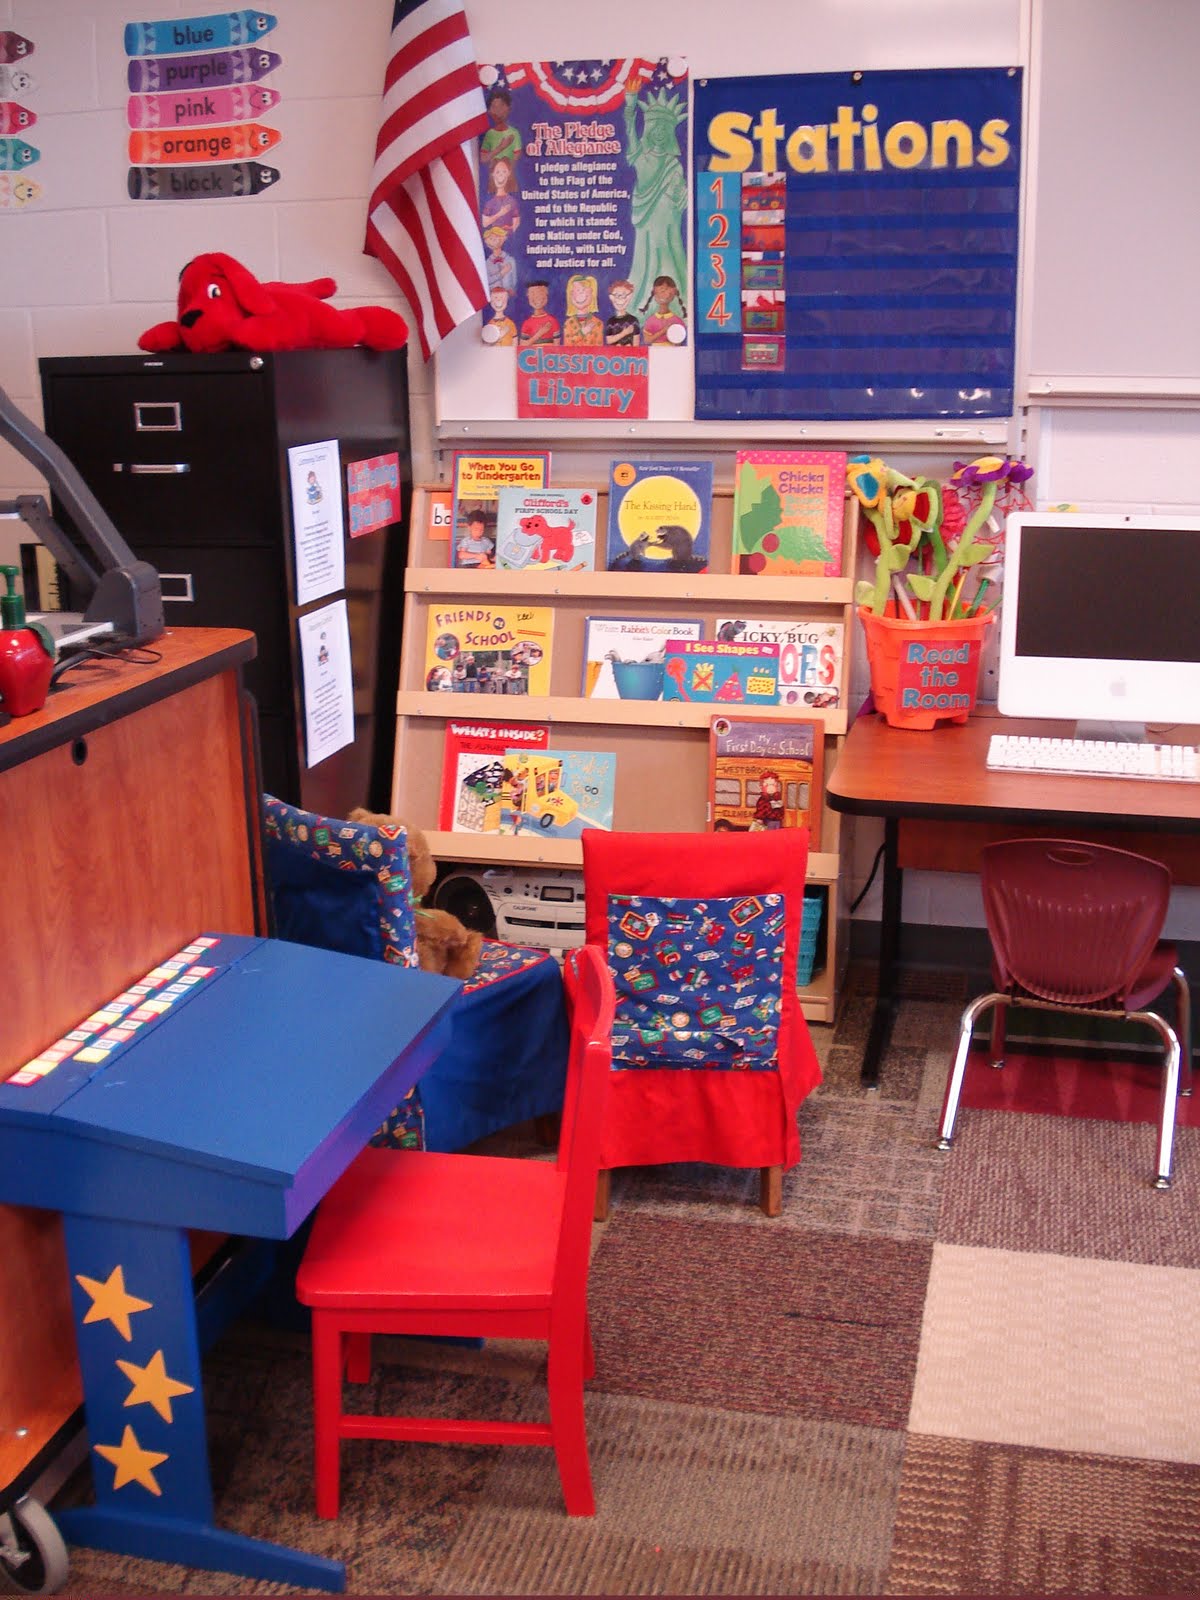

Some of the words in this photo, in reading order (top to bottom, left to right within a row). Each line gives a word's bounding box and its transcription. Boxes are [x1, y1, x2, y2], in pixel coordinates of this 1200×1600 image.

[172, 26, 214, 46] blue
[166, 59, 228, 85] purple
[175, 98, 216, 123] pink
[532, 122, 562, 139] The
[564, 121, 615, 140] Pledge
[707, 103, 1010, 173] Stations
[163, 135, 232, 157] orange
[526, 140, 542, 156] of
[546, 139, 621, 158] Allegiance
[535, 163, 539, 172] I
[541, 162, 569, 174] pledge
[571, 162, 617, 173] allegiance
[171, 173, 223, 192] black
[539, 177, 549, 186] to
[550, 177, 564, 186] the
[566, 176, 585, 187] Flag
[587, 175, 597, 185] of
[598, 175, 613, 185] the
[522, 190, 549, 200] United
[551, 190, 579, 200] States
[581, 190, 590, 199] of
[592, 189, 630, 200] America,
[710, 176, 724, 209] 1
[535, 204, 551, 214] and
[553, 204, 562, 213] to
[564, 204, 578, 213] the
[580, 203, 617, 214] Republic
[535, 218, 547, 227] for
[549, 217, 576, 227] which
[577, 217, 584, 227] it
[529, 232, 545, 241] one
[547, 231, 575, 240] Nation
[577, 231, 601, 240] under
[603, 230, 623, 241] God,
[708, 214, 730, 248] 2
[526, 244, 573, 255] indivisible,
[576, 244, 595, 254] with
[597, 244, 626, 255] Liberty
[536, 258, 552, 268] and
[554, 258, 585, 267] Justice
[587, 258, 600, 267] for
[601, 257, 616, 267] all.
[711, 254, 726, 289] 3
[706, 293, 732, 327] 4
[518, 348, 648, 376] Classroom
[529, 378, 635, 413] Library
[468, 462, 496, 471] When
[498, 462, 517, 471] You
[520, 462, 534, 471] Go
[462, 472, 472, 480] to
[475, 471, 541, 482] Kindergarten
[779, 471, 824, 482] Chicka
[779, 483, 824, 494] Chicka
[624, 500, 641, 510] The
[642, 501, 672, 511] Kissing
[673, 501, 697, 511] Hand
[435, 610, 491, 627] FRIENDS
[465, 631, 516, 646] SCHOOL
[620, 625, 650, 634] Rabbit's
[650, 626, 671, 635] Color
[672, 627, 694, 635] Book
[787, 633, 819, 644] BUG
[685, 642, 691, 651] I
[693, 643, 715, 653] See
[716, 644, 759, 656] Shapes
[907, 642, 970, 664] Read
[920, 666, 959, 687] the
[902, 687, 970, 709] Room
[450, 723, 497, 739] WHAT'S
[498, 728, 545, 741] INSIDE?
[726, 740, 748, 753] First
[750, 741, 766, 757] Day
[778, 740, 811, 756] School
